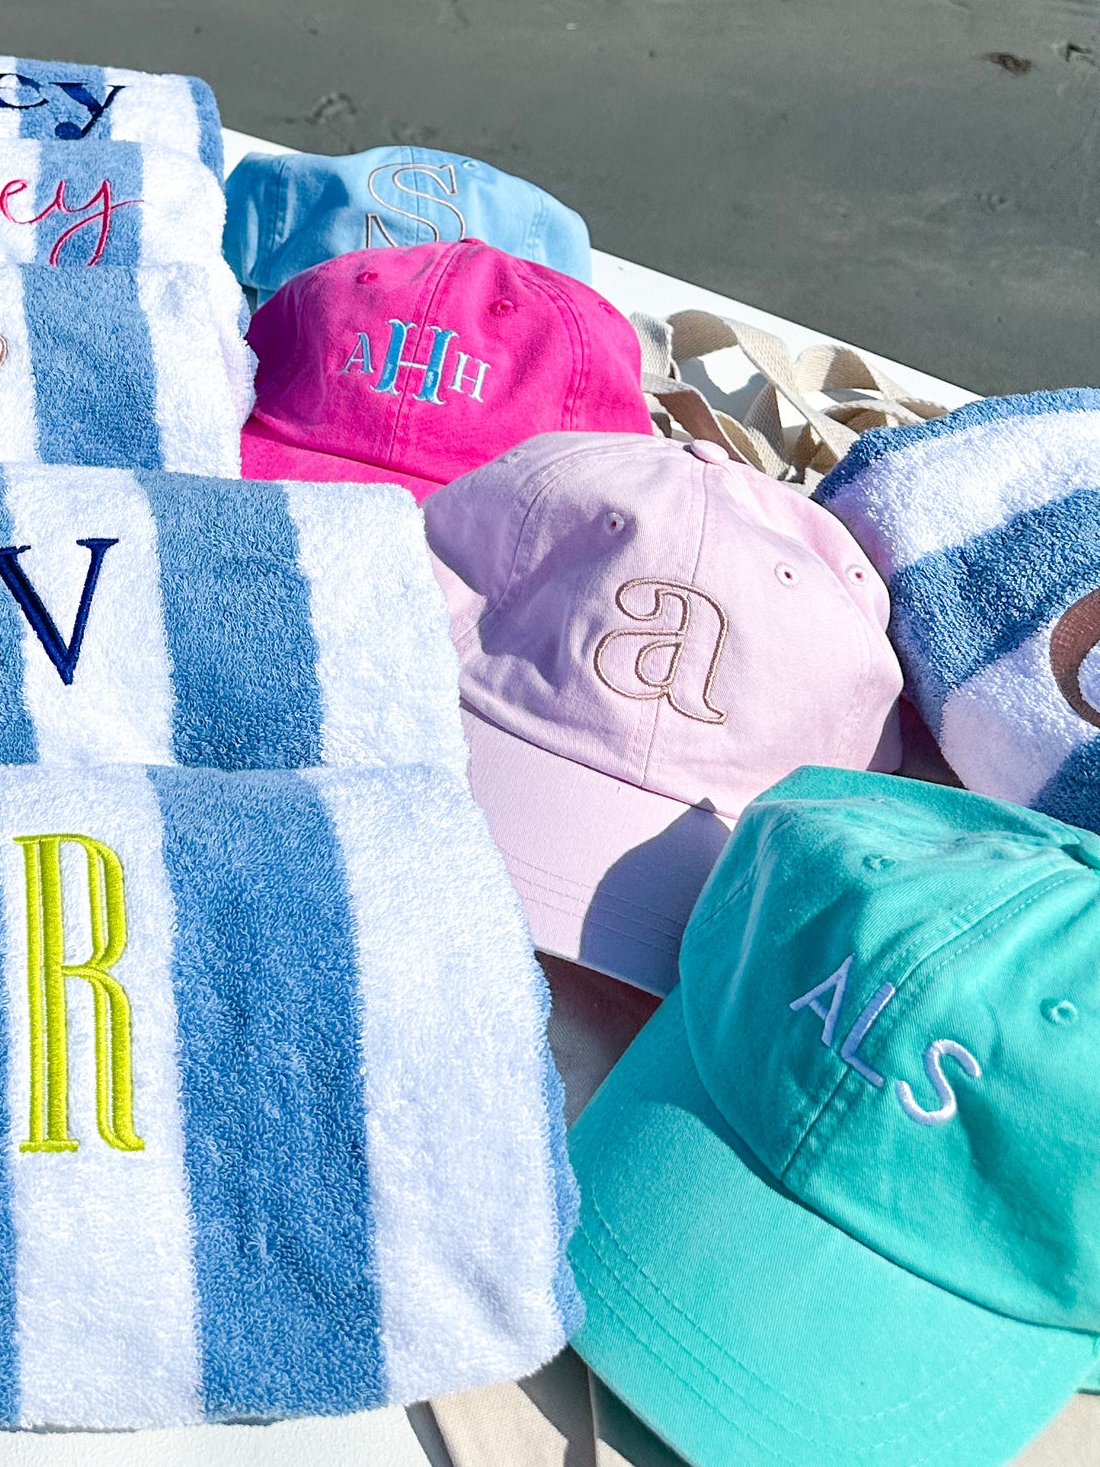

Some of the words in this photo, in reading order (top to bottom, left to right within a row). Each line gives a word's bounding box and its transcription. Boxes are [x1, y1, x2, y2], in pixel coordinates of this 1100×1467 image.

[366, 162, 466, 248] S
[339, 318, 492, 405] AHH
[593, 577, 728, 725] a
[789, 954, 981, 1127] ALS
